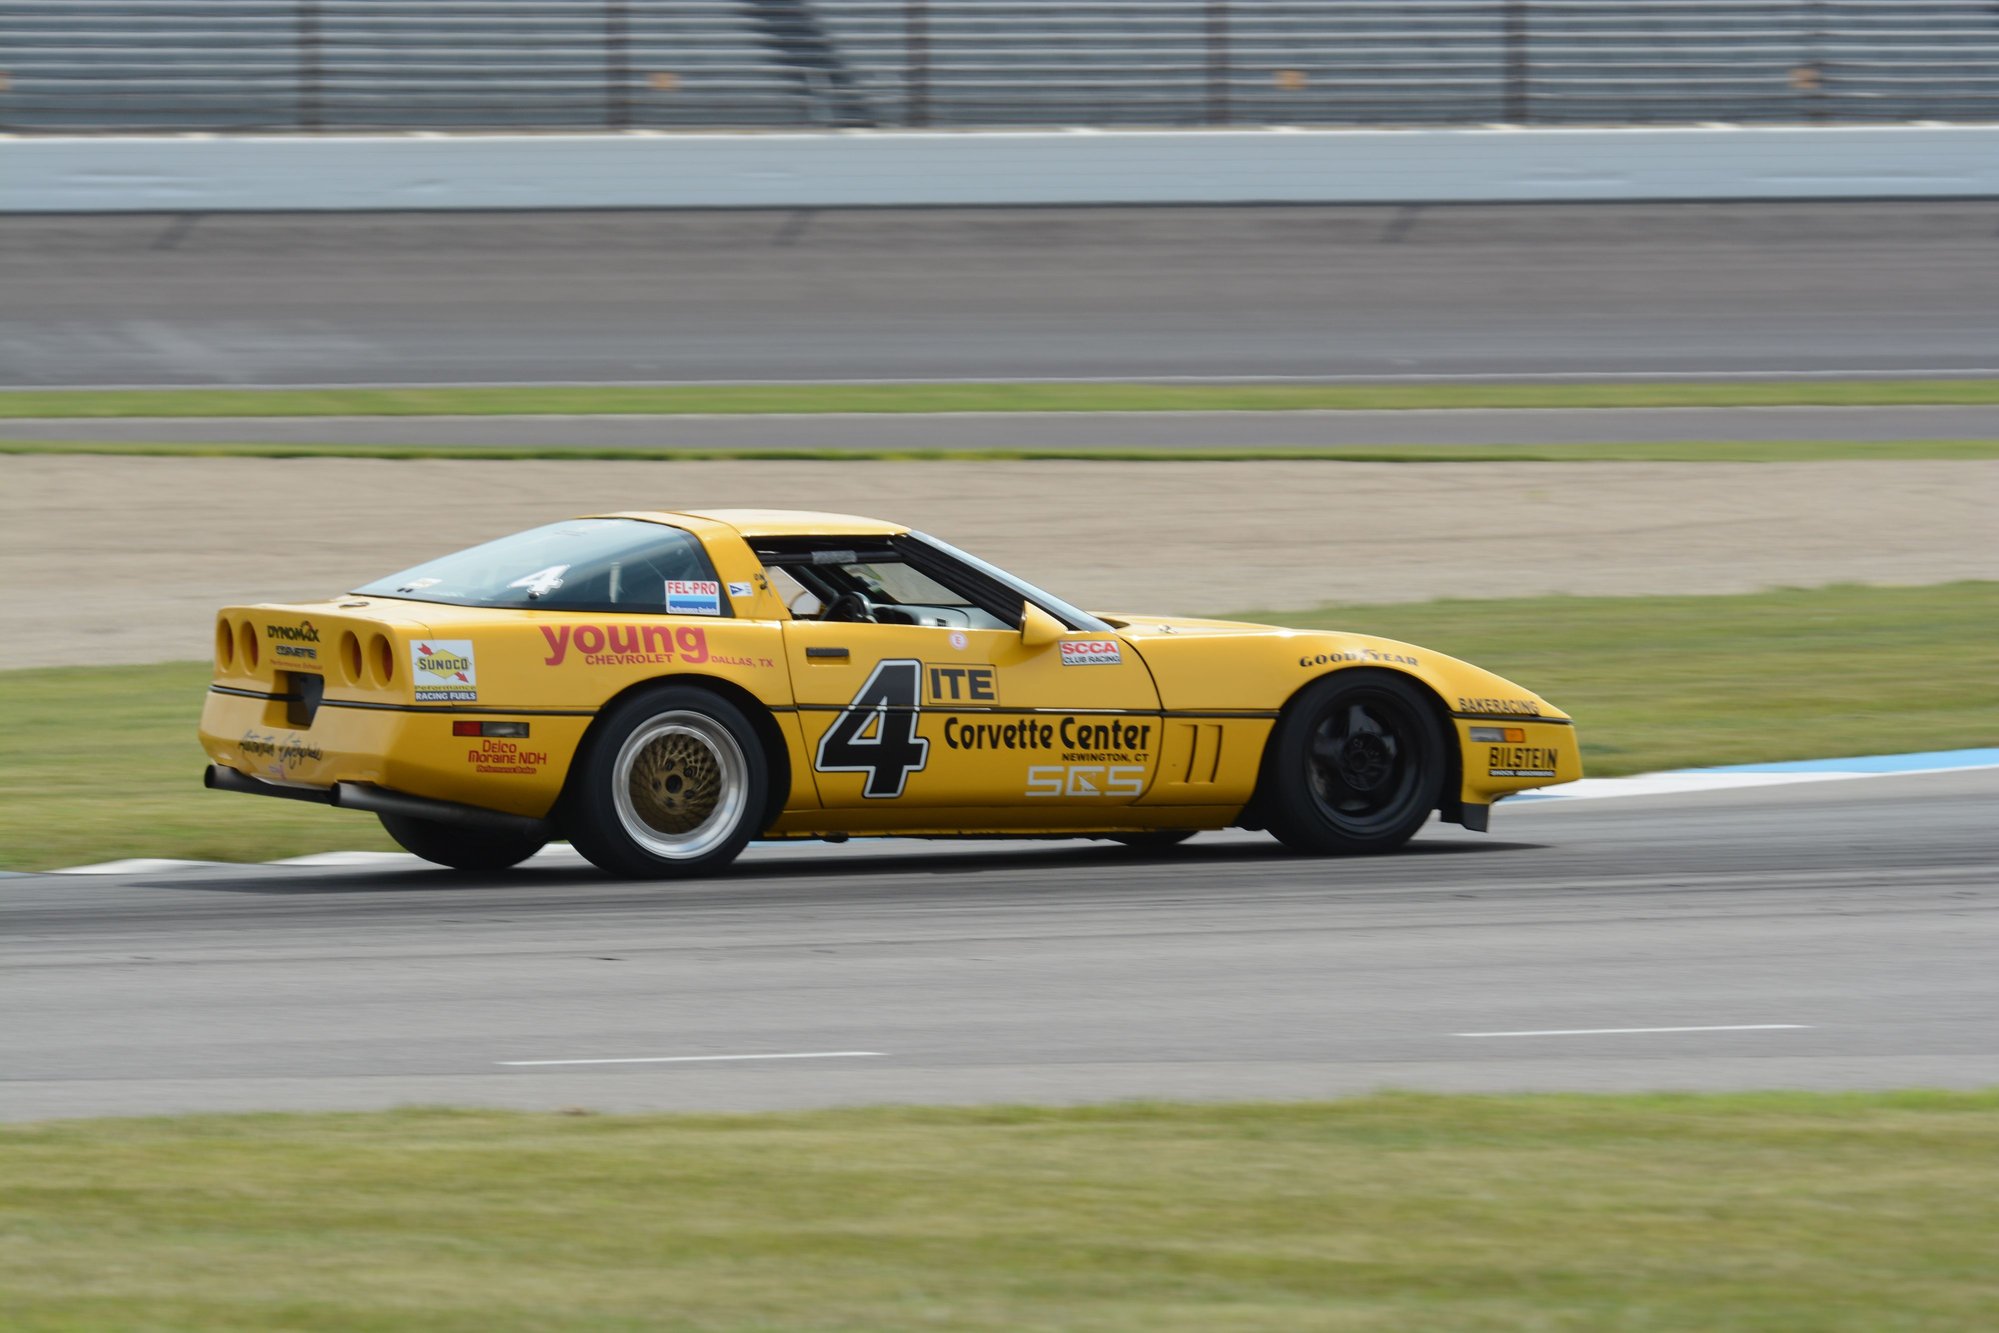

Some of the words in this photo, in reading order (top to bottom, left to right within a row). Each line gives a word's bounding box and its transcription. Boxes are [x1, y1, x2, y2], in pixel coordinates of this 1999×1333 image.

[667, 582, 717, 595] FEL-PRO
[540, 624, 709, 666] young
[1062, 642, 1117, 654] SCCA
[418, 657, 469, 671] SUNOCO
[585, 654, 673, 665] CHEVROLET
[711, 655, 756, 667] DALLAS,
[759, 658, 774, 667] TX
[930, 668, 995, 700] ITE
[415, 692, 449, 700] RACING
[450, 692, 476, 700] FUELS
[814, 658, 931, 800] 4
[944, 716, 1054, 751] Corvette
[1060, 716, 1151, 751] Center
[482, 739, 517, 753] Delco
[468, 750, 517, 764] Moraine
[518, 752, 547, 765] NDH
[1061, 753, 1132, 763] NEWINGTON,
[1135, 753, 1149, 762] CT
[1489, 746, 1558, 769] BILSTEIN
